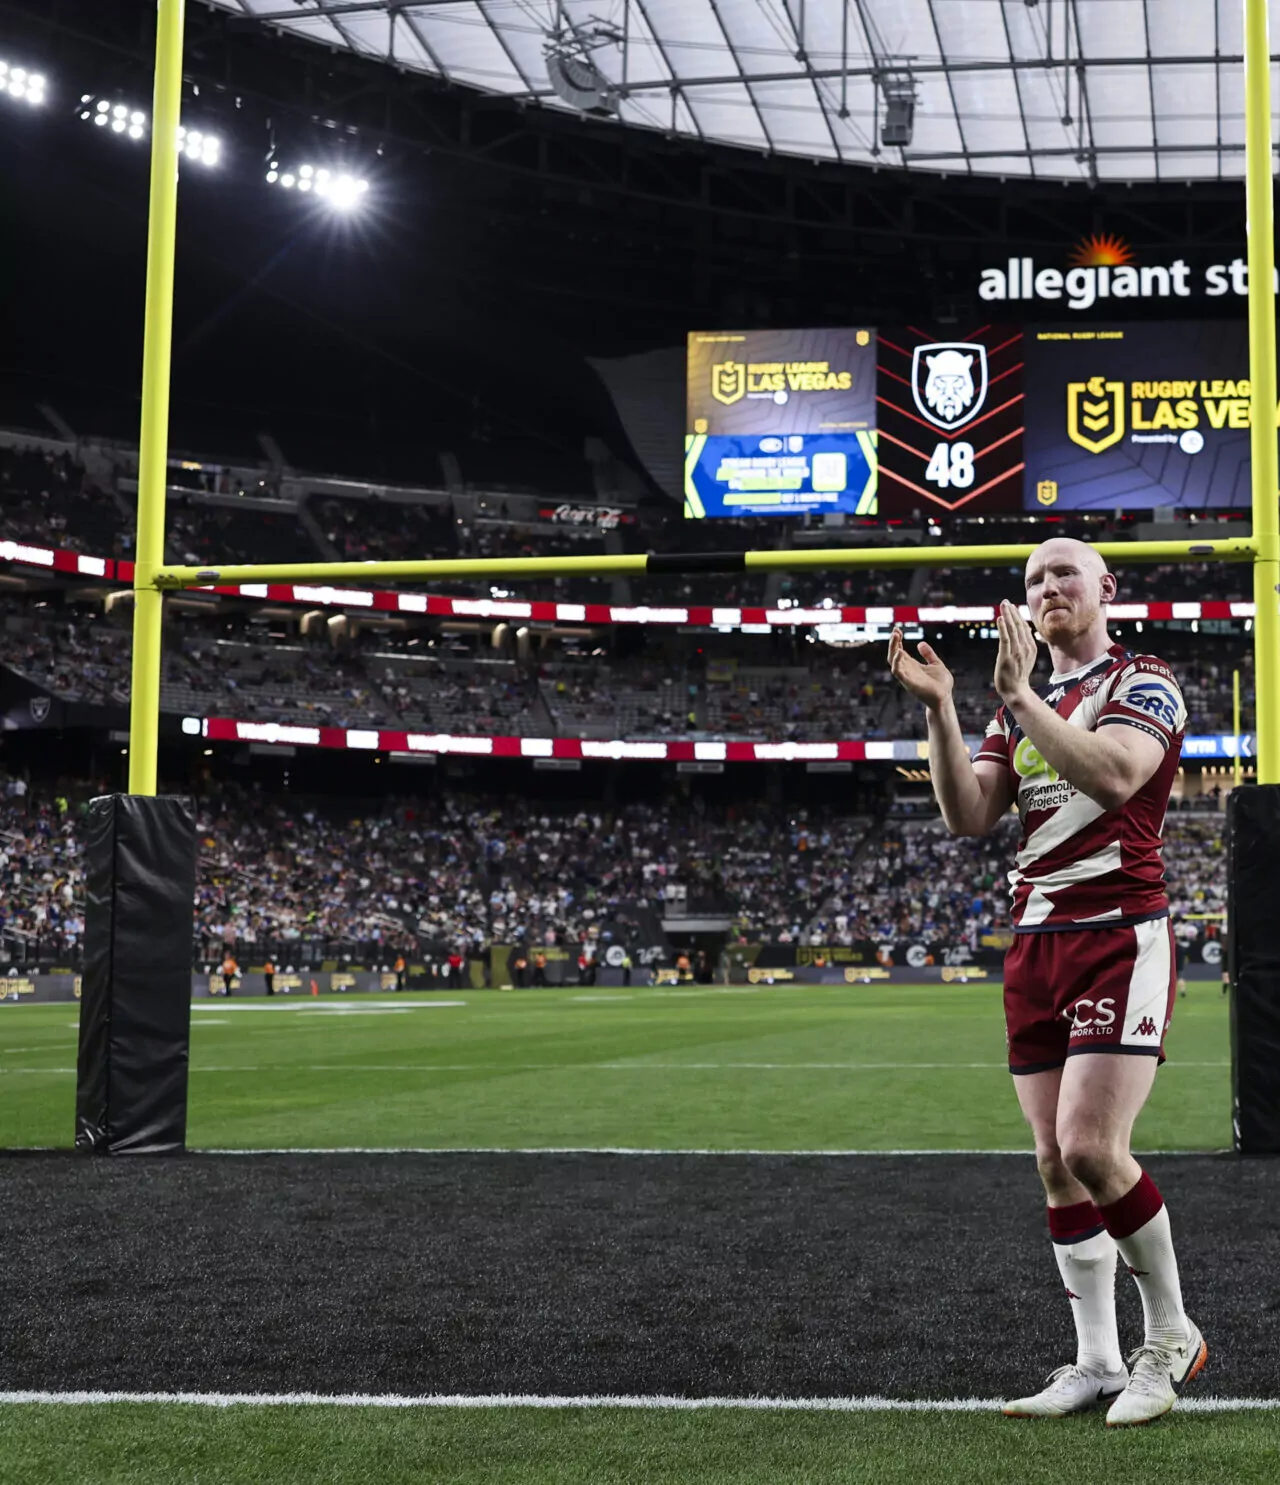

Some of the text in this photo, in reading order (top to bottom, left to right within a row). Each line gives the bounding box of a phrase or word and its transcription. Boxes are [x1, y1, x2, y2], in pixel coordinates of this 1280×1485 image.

[979, 258, 1190, 309] allegiant
[747, 372, 852, 391] LAS VEGAS
[1131, 380, 1251, 399] RUGBY LEAG
[1131, 400, 1199, 430] LAS
[925, 441, 975, 488] 48
[1029, 793, 1069, 809] Projects
[1096, 1026, 1114, 1035] LTD
